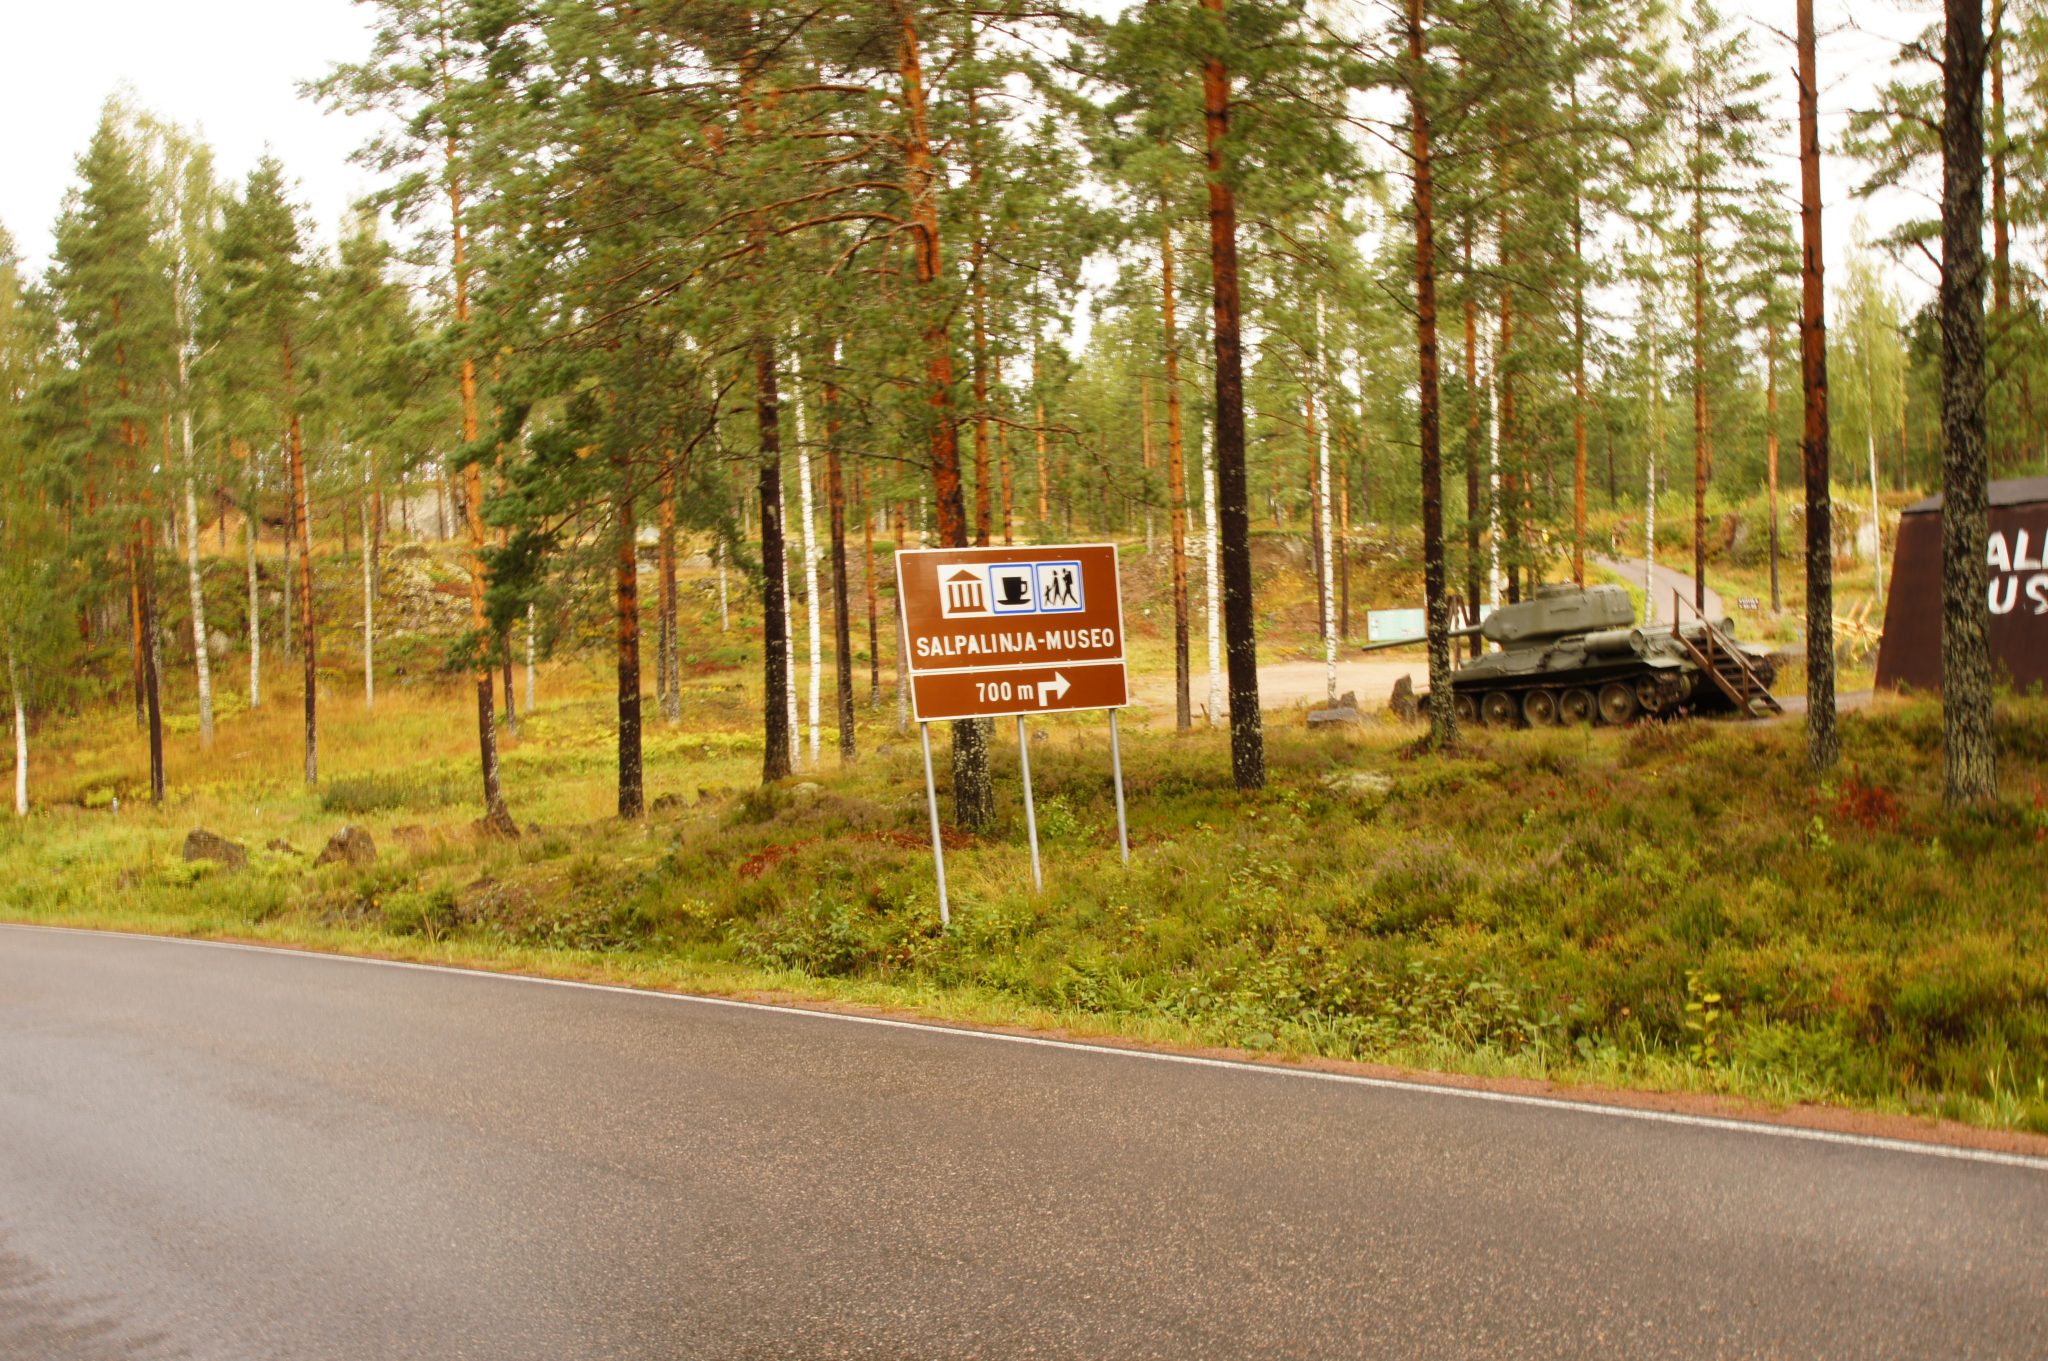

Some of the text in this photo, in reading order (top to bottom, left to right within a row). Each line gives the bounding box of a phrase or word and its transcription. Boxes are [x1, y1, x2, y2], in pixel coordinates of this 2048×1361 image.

[1987, 528, 2048, 572] AL
[916, 628, 1115, 657] SALPALINJA-MUSEO
[975, 681, 1034, 703] 700 m
